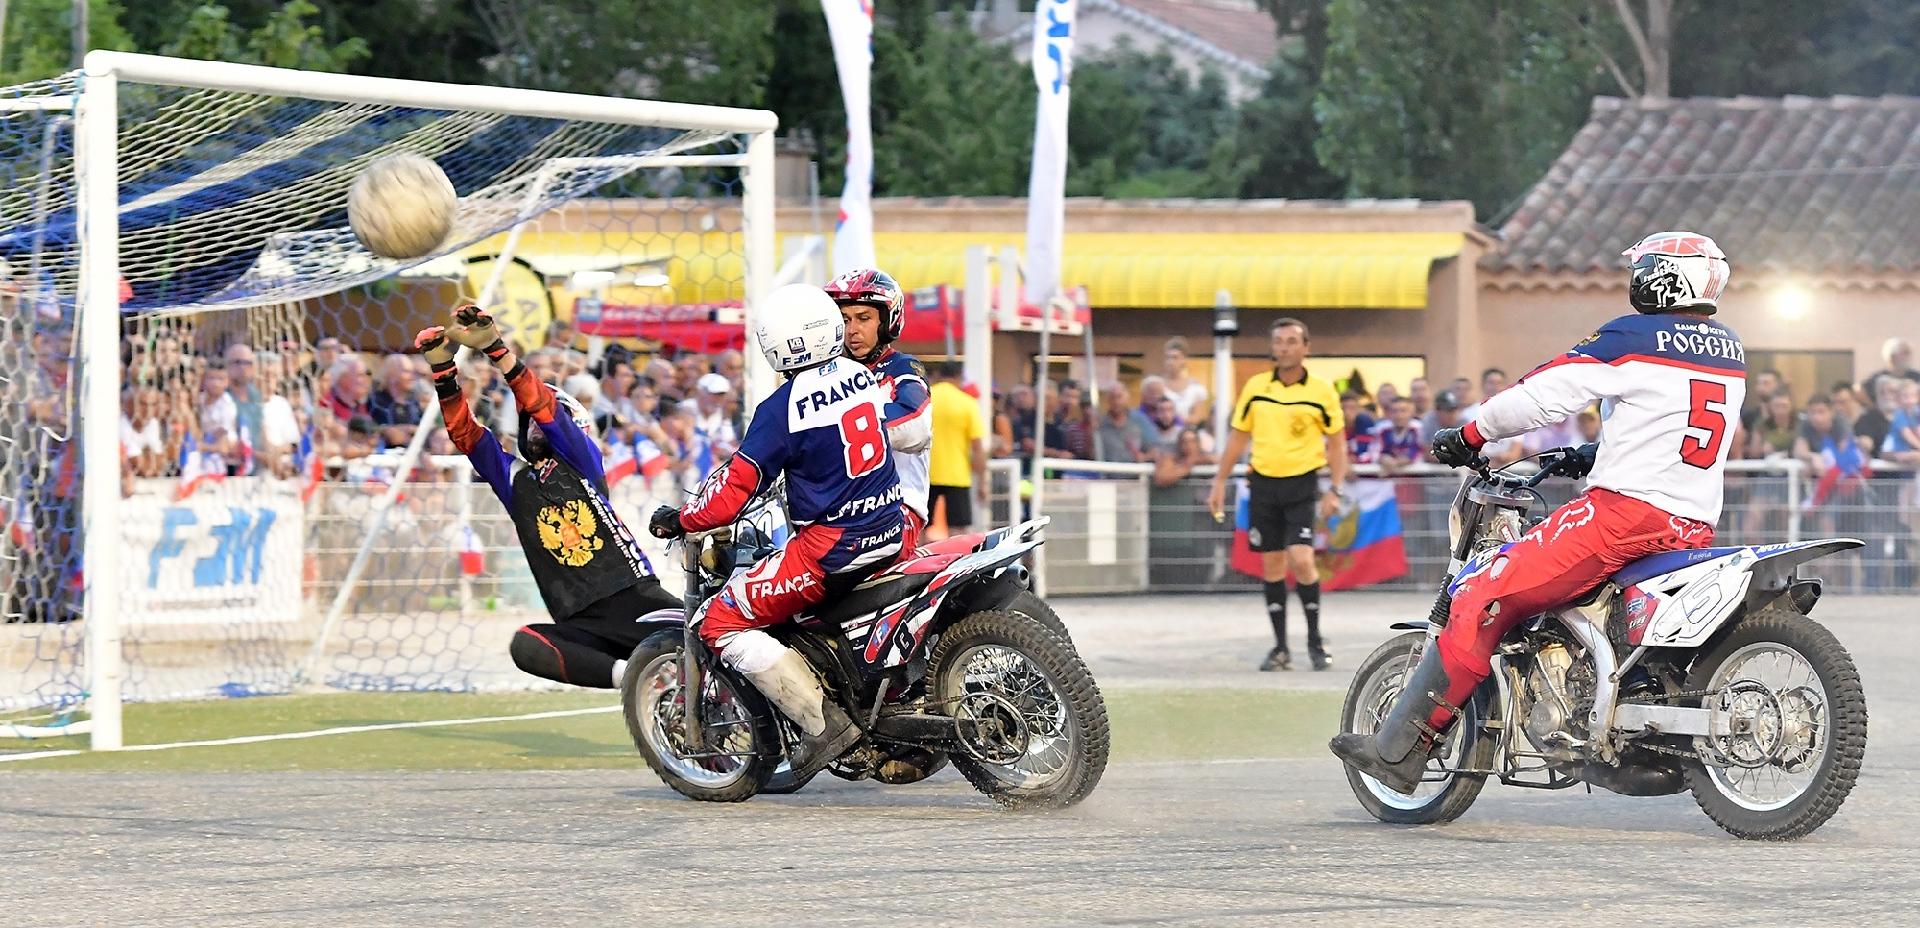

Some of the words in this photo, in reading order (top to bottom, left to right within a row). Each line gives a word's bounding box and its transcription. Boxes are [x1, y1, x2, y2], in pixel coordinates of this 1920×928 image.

[1655, 330, 1746, 365] РОССИЯ
[841, 401, 886, 478] 8
[1679, 378, 1727, 470] 5
[751, 572, 816, 599] FRANCE
